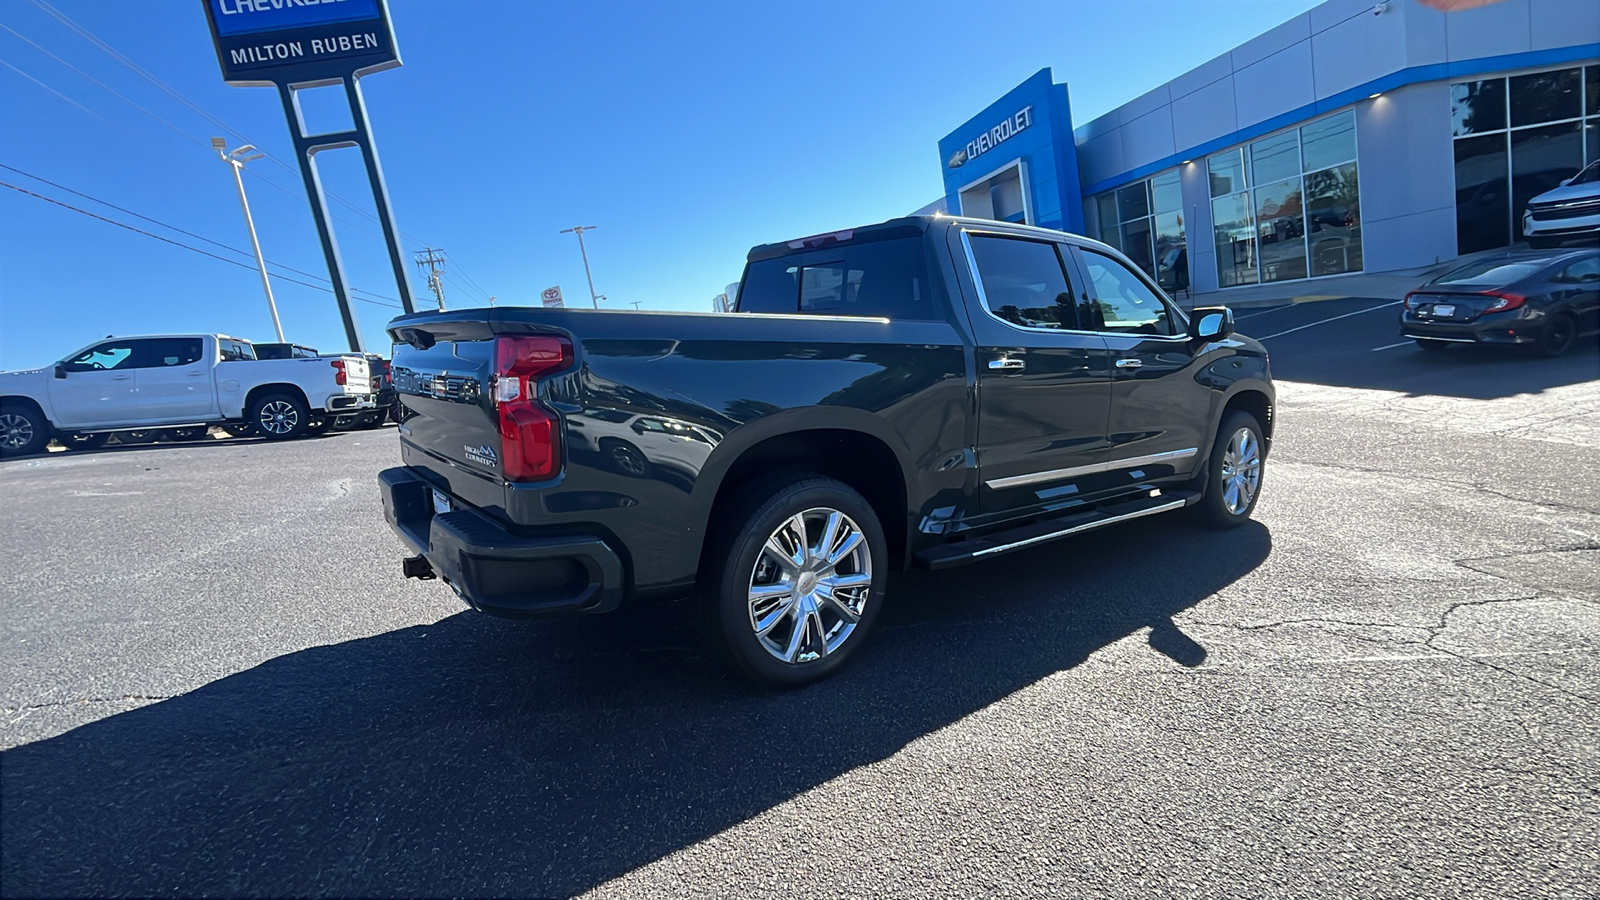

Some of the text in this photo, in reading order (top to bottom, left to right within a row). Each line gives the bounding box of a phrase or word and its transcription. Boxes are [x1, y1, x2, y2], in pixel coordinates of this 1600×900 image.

[231, 33, 378, 64] MILTON RUBEN
[966, 105, 1033, 160] CHEVROLET
